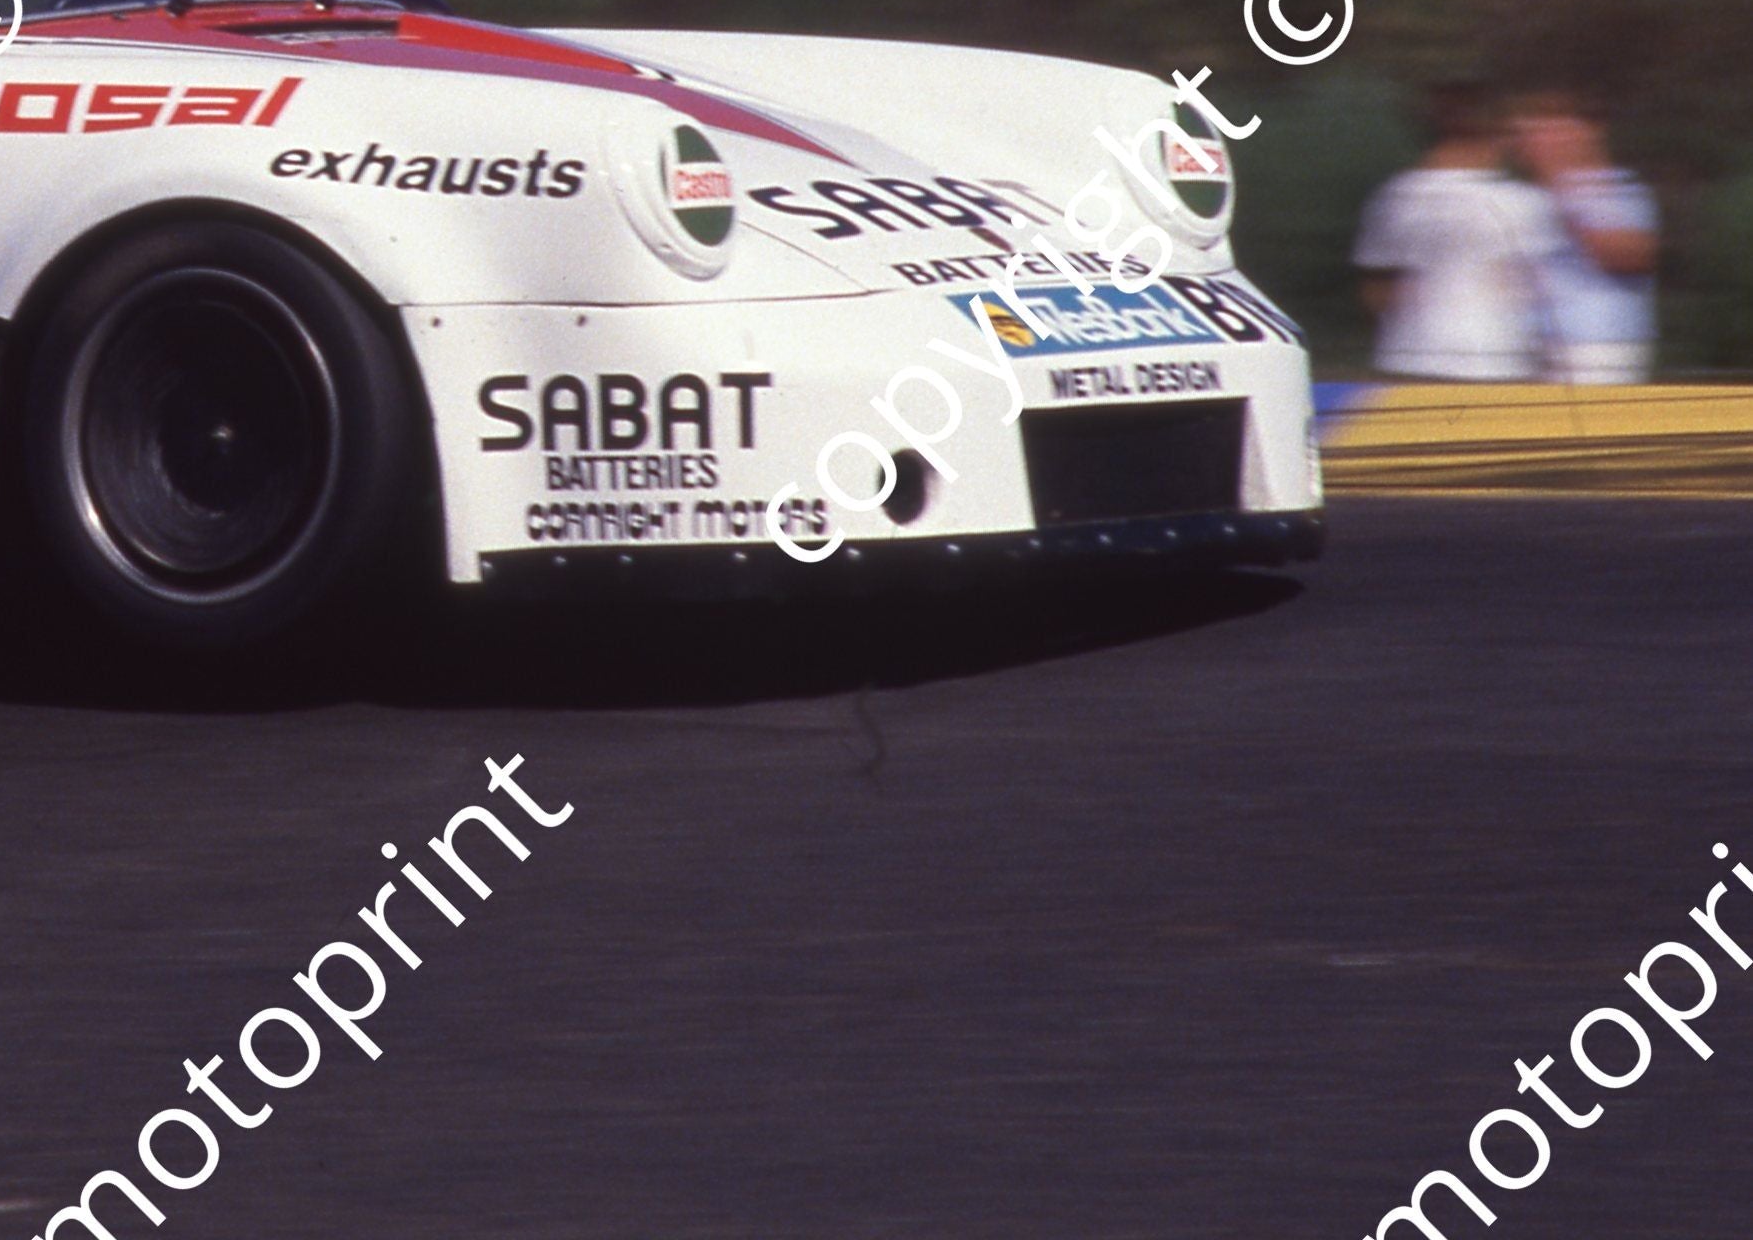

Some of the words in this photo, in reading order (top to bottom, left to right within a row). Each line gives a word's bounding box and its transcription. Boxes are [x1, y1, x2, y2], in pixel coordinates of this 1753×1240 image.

[269, 143, 586, 198] exhausts
[747, 176, 1089, 239] SABAT
[1050, 366, 1130, 399] METAL
[1135, 361, 1222, 393] DESIGN
[478, 373, 772, 452] SABAT
[547, 455, 718, 491] BATTERIES
